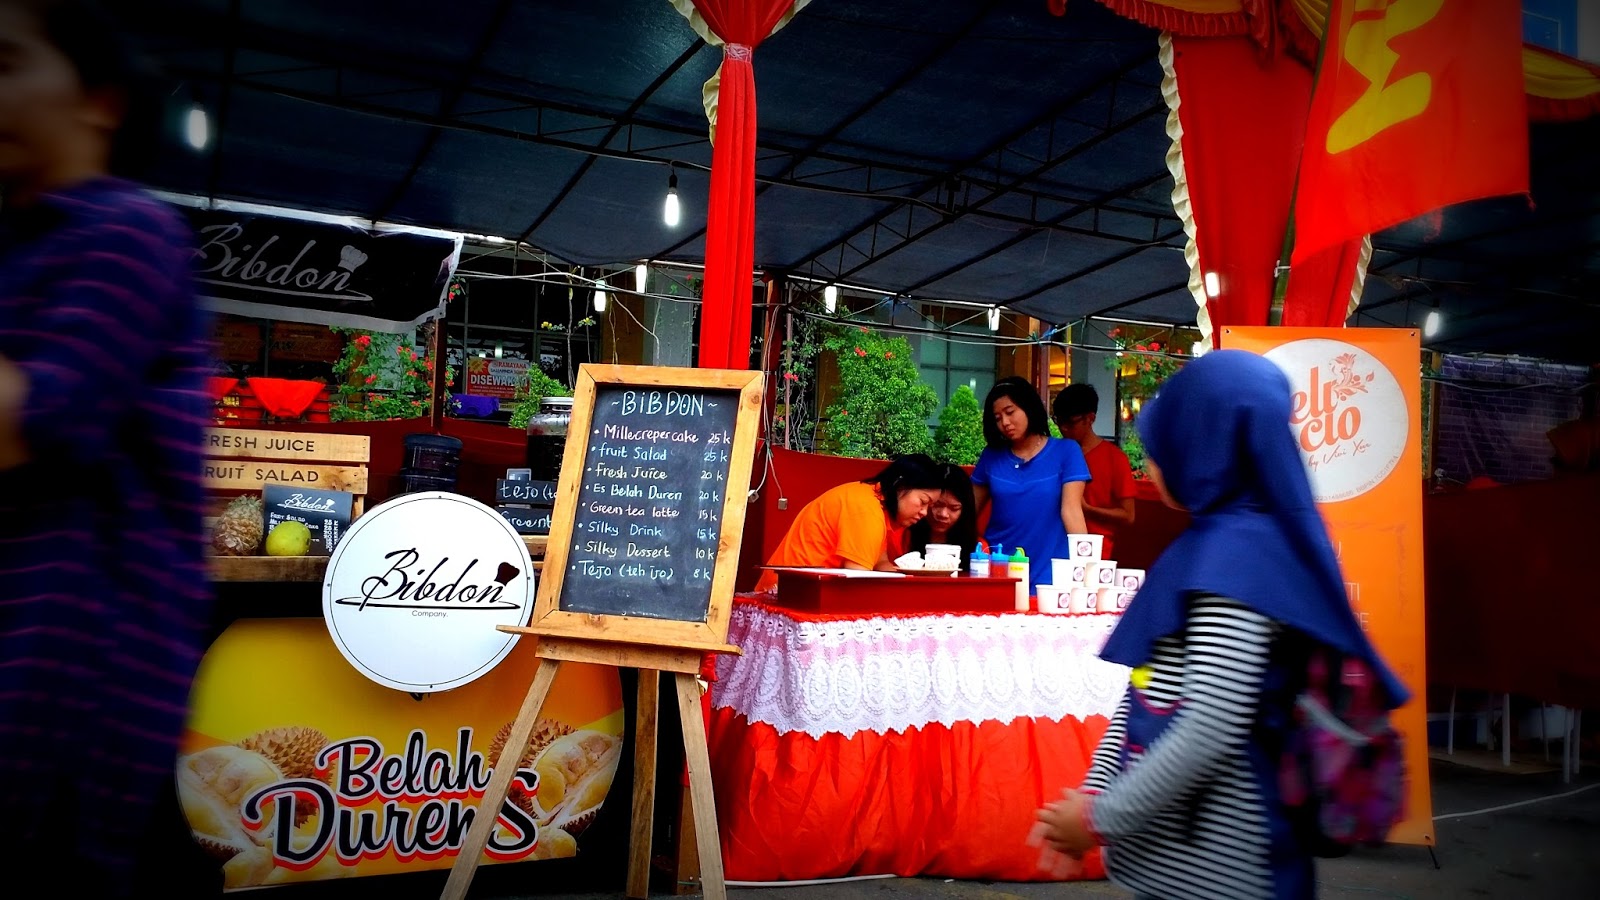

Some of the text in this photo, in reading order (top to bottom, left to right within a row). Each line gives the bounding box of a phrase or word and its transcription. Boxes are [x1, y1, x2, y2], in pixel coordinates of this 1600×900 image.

[191, 222, 351, 291] Bibdon
[671, 429, 699, 443] cake
[265, 438, 315, 452] JUICE
[633, 447, 667, 460] Salad
[204, 464, 319, 482] RUIT SALAD
[631, 466, 668, 480] Juice
[593, 483, 606, 493] Es
[610, 484, 643, 498] Belah
[648, 485, 682, 500] Duren
[590, 501, 623, 515] Green
[625, 504, 645, 516] tea
[587, 521, 619, 536] Silky
[629, 523, 662, 536] Drink
[584, 541, 618, 558] Silky
[626, 542, 671, 558] Dessert
[358, 548, 504, 612] Bibdon
[316, 727, 492, 804] Belah
